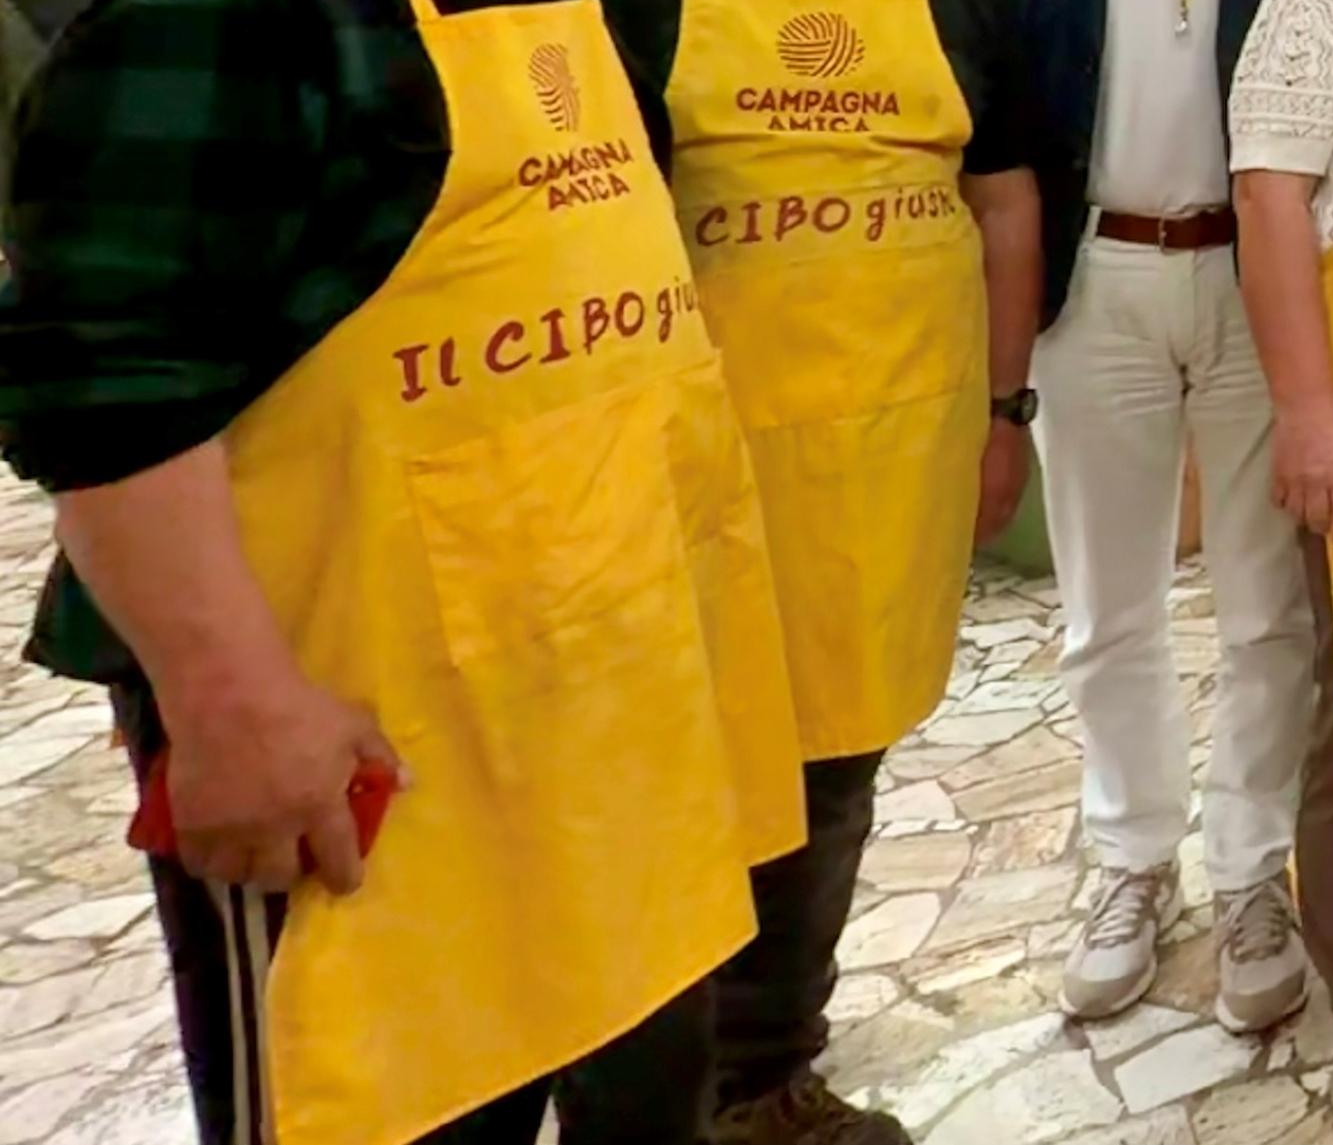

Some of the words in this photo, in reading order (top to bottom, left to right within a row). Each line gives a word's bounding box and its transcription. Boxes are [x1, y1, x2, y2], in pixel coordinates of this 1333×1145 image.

[735, 87, 901, 116] CAMPAGNA
[767, 114, 871, 133] AMICA
[694, 195, 852, 247] CIBO
[392, 336, 462, 403] Il
[483, 290, 646, 375] CIBO
